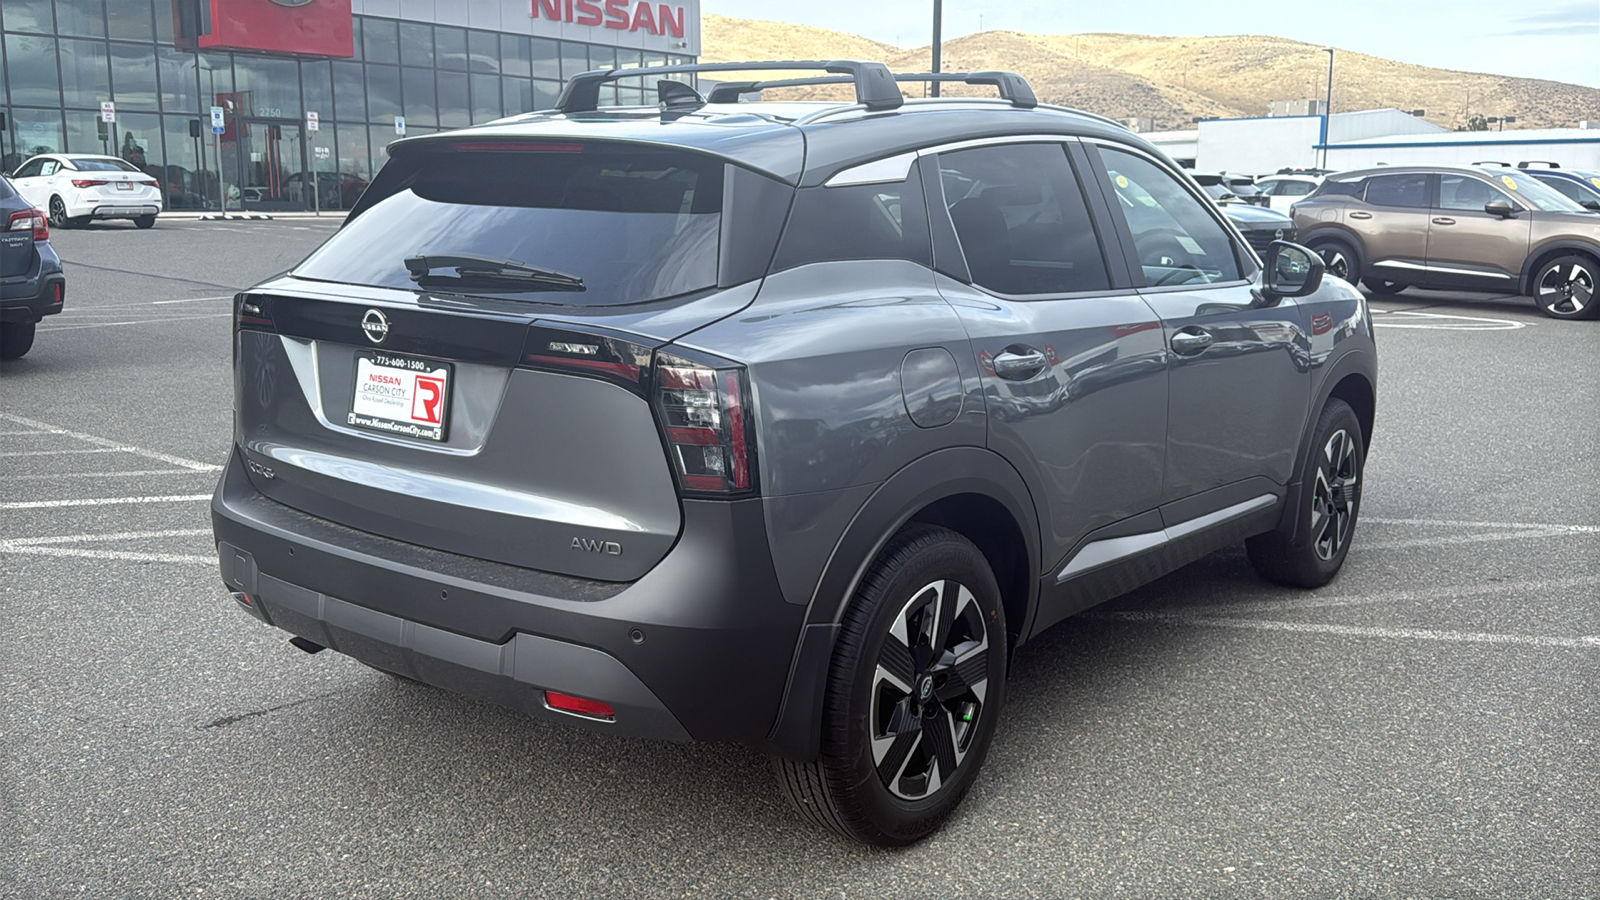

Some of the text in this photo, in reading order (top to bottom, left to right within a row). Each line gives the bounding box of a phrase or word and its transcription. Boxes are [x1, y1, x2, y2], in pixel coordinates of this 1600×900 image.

[530, 0, 685, 38] NISSAN
[260, 107, 281, 118] 2750
[376, 355, 425, 370] 775-600-1500
[369, 373, 402, 386] NISSAN
[363, 383, 406, 398] CARSON CITY
[356, 417, 433, 438] www.NissanCarsonCity.com
[570, 536, 621, 556] AWD
